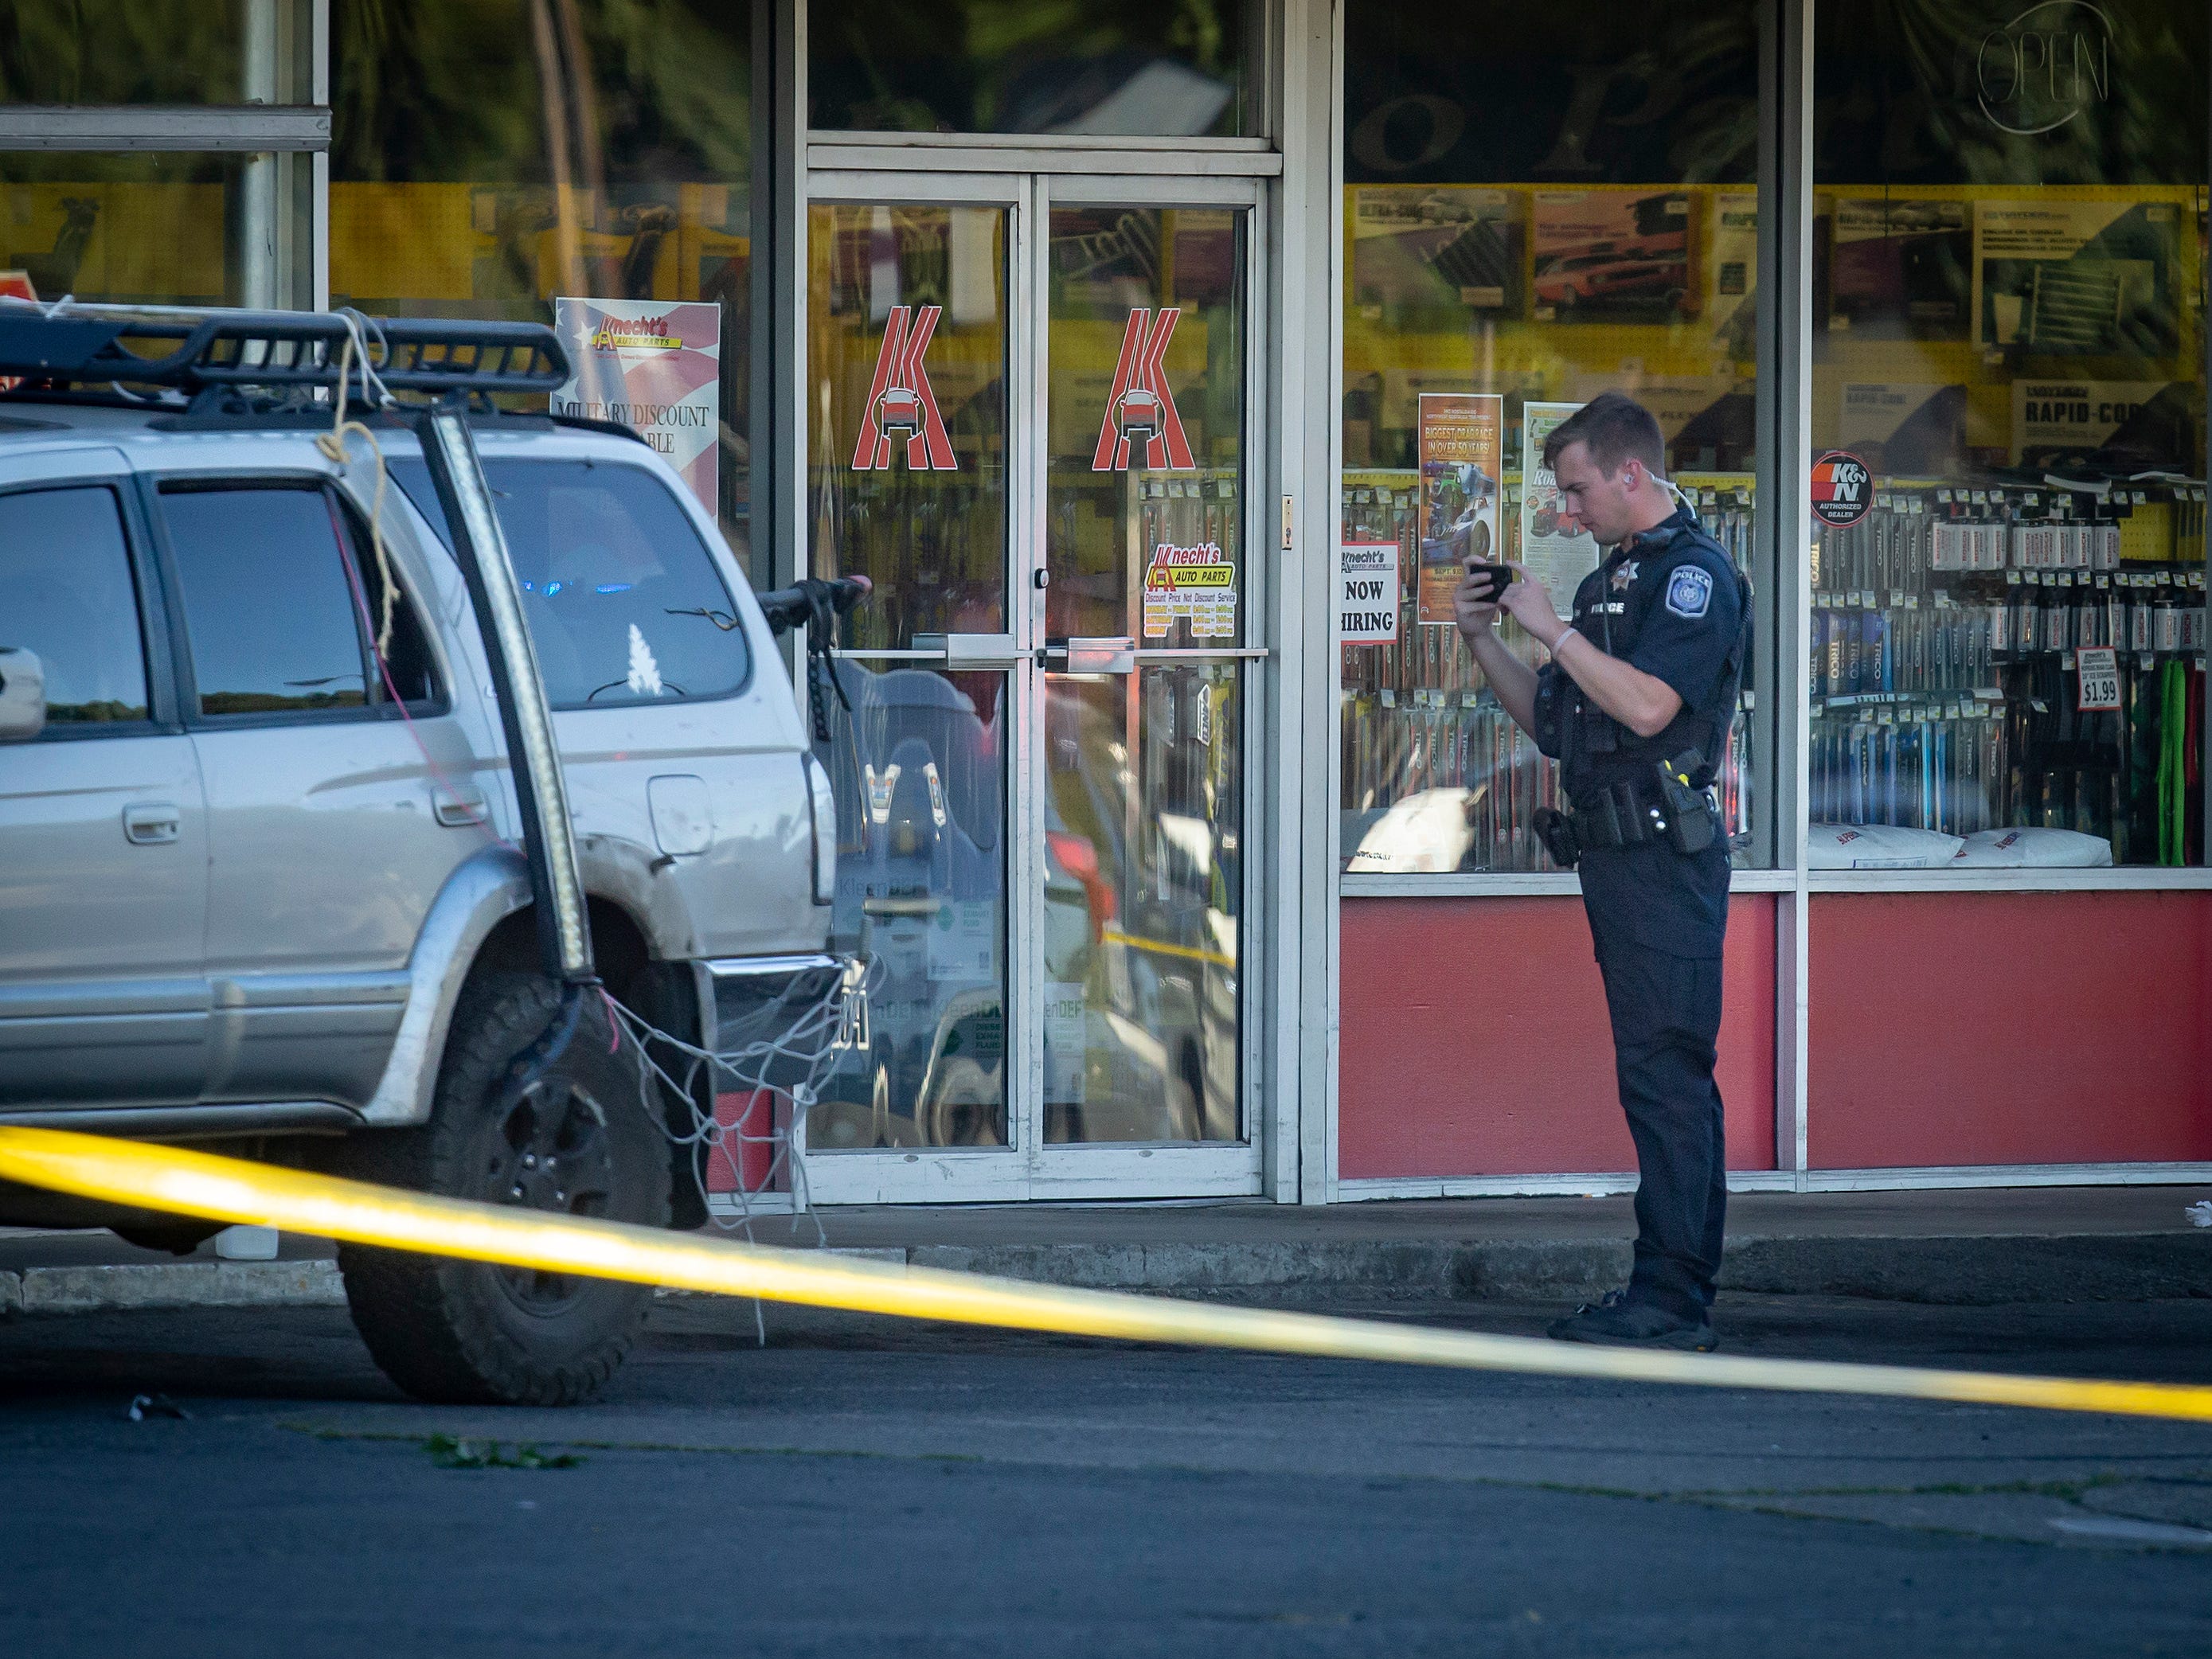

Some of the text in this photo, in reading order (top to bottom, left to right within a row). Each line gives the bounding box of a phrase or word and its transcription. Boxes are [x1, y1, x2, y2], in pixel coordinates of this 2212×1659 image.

[1977, 30, 2108, 102] OPEN
[634, 403, 709, 427] DISCOUNT
[1425, 427, 1456, 440] BIGGEST
[1428, 441, 1436, 453] IN
[1437, 441, 1456, 455] OVER
[1458, 441, 1468, 455] 50
[1148, 545, 1220, 591] Knecht's
[1174, 571, 1227, 582] AUTO PARTS
[1345, 580, 1384, 600] NOW
[1674, 572, 1710, 588] POLICE
[1146, 593, 1236, 602] Discount Price Not Discount Service
[1830, 639, 1839, 679] TRICO
[2085, 681, 2116, 703] $1.99
